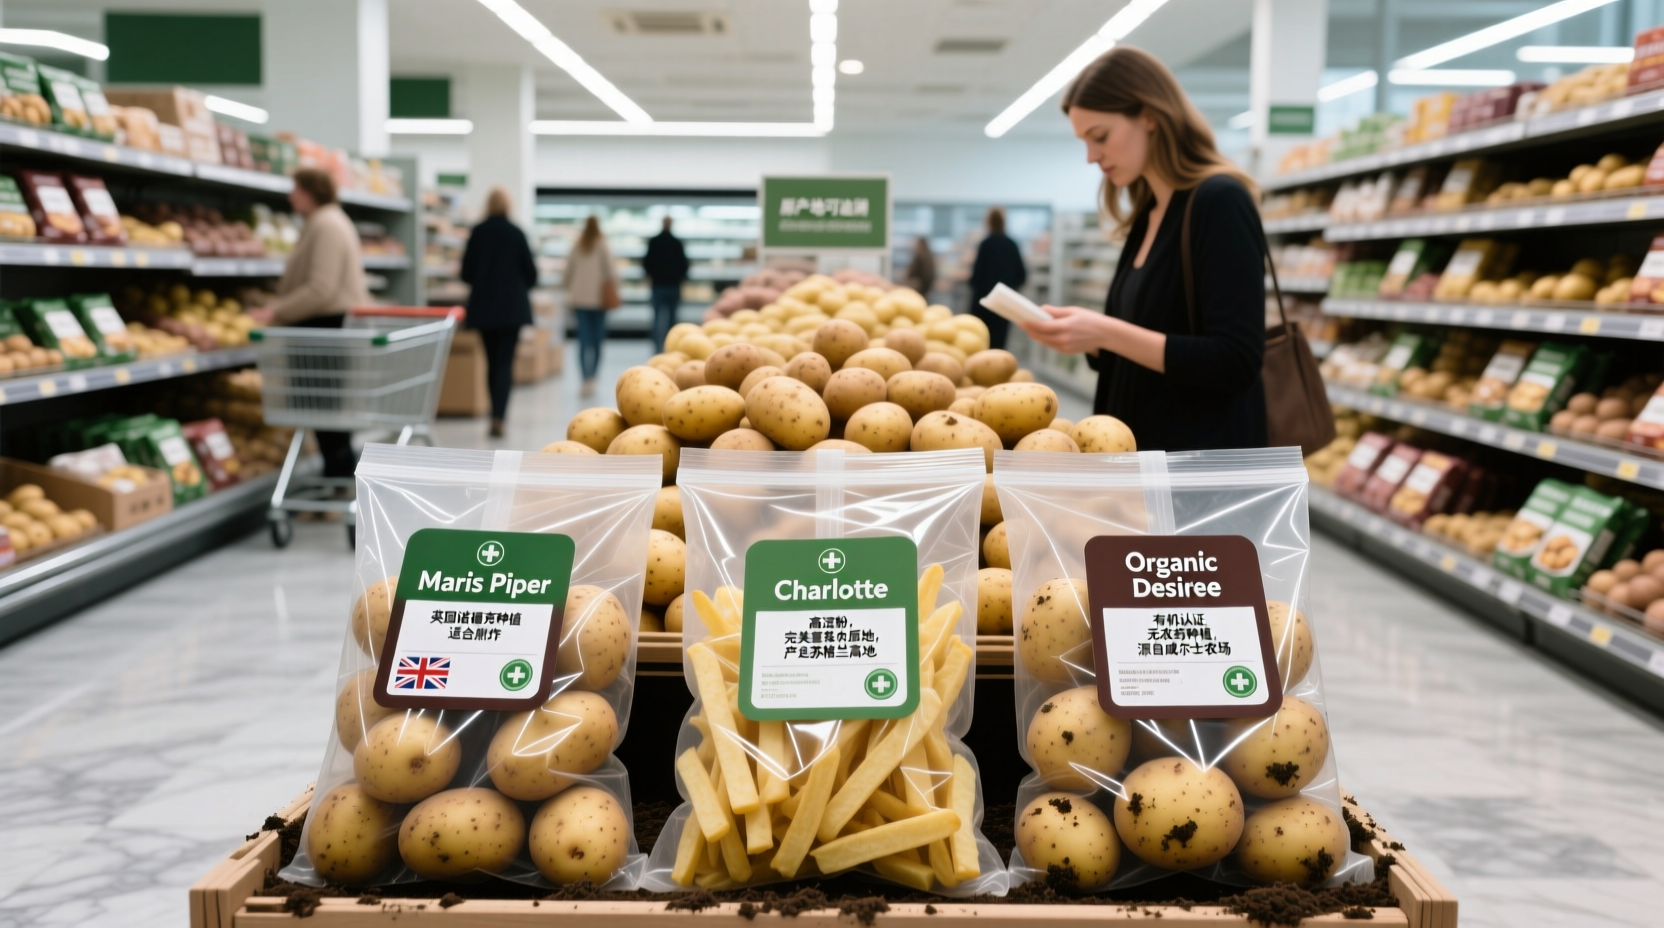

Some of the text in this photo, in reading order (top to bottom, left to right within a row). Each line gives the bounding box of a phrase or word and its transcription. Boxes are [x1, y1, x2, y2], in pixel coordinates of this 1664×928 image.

[1126, 551, 1218, 578] Organic
[418, 571, 551, 598] Maris Piper
[775, 578, 888, 600] Charlotte
[1133, 576, 1221, 597] Desiree
